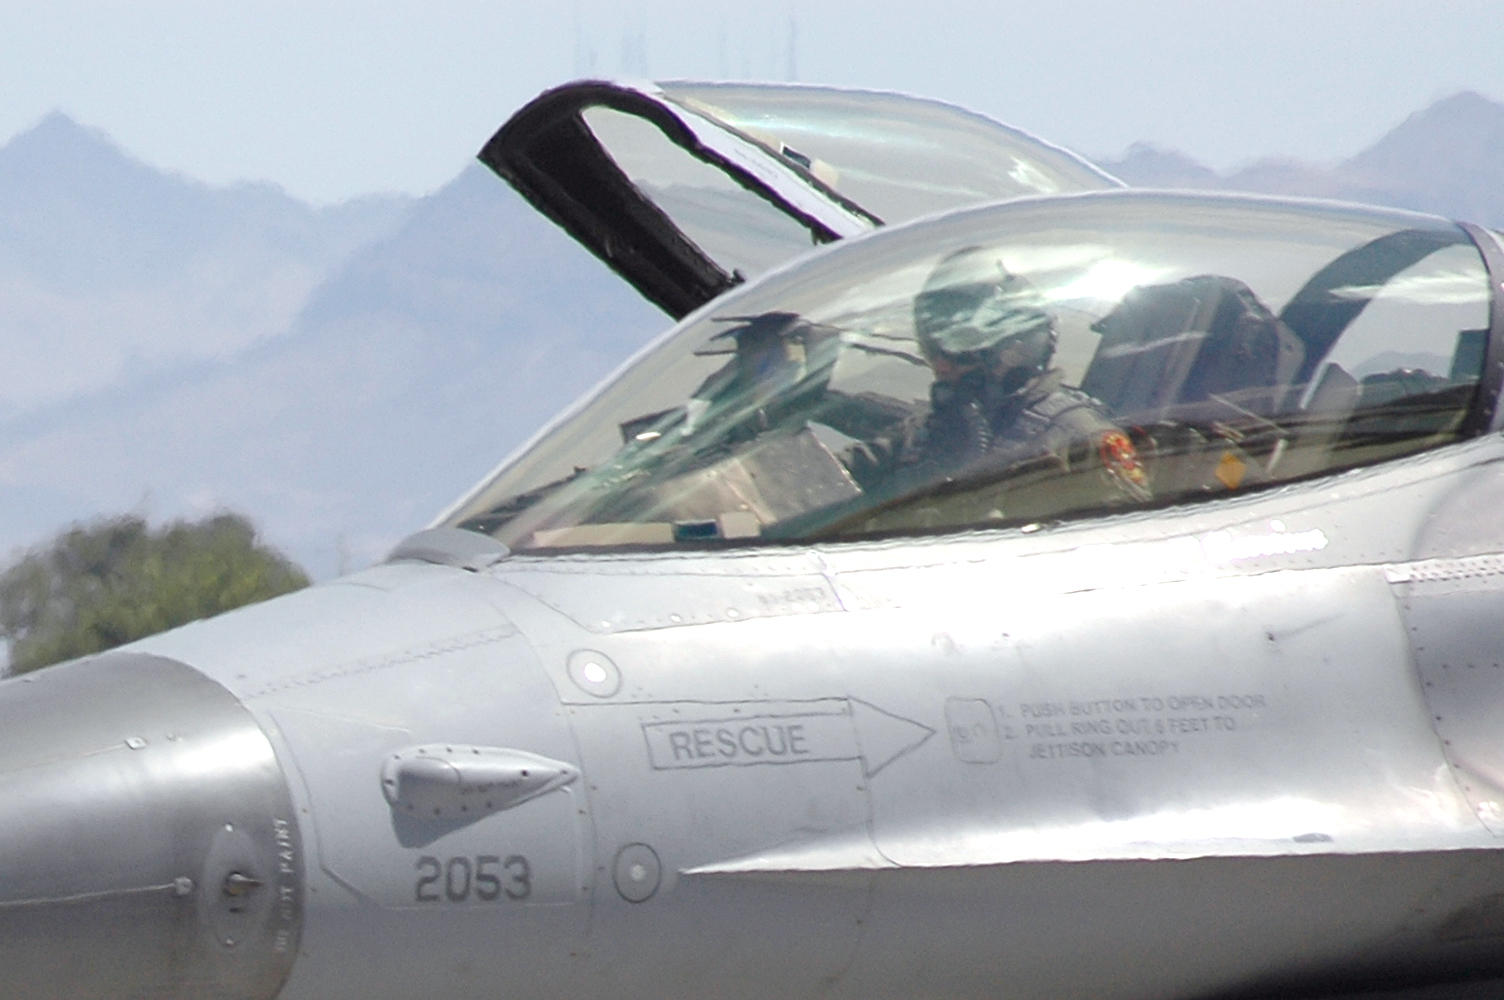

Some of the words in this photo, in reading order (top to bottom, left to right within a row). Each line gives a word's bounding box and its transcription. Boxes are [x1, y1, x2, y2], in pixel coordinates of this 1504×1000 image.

[1020, 702, 1066, 718] PUSH
[1069, 699, 1136, 717] BUTTON
[1141, 697, 1164, 712] TO
[1169, 695, 1214, 711] OPEN
[1217, 693, 1266, 709] DOOR
[1026, 722, 1066, 738] PULL
[1071, 719, 1112, 735] RING
[1118, 718, 1151, 735] OUT
[1168, 717, 1210, 733] FEET
[1214, 715, 1237, 731] TO
[668, 724, 810, 762] RESCUE
[1029, 740, 1107, 760] JETTISON
[1111, 738, 1180, 757] CANOPY
[414, 854, 533, 902] 2053
